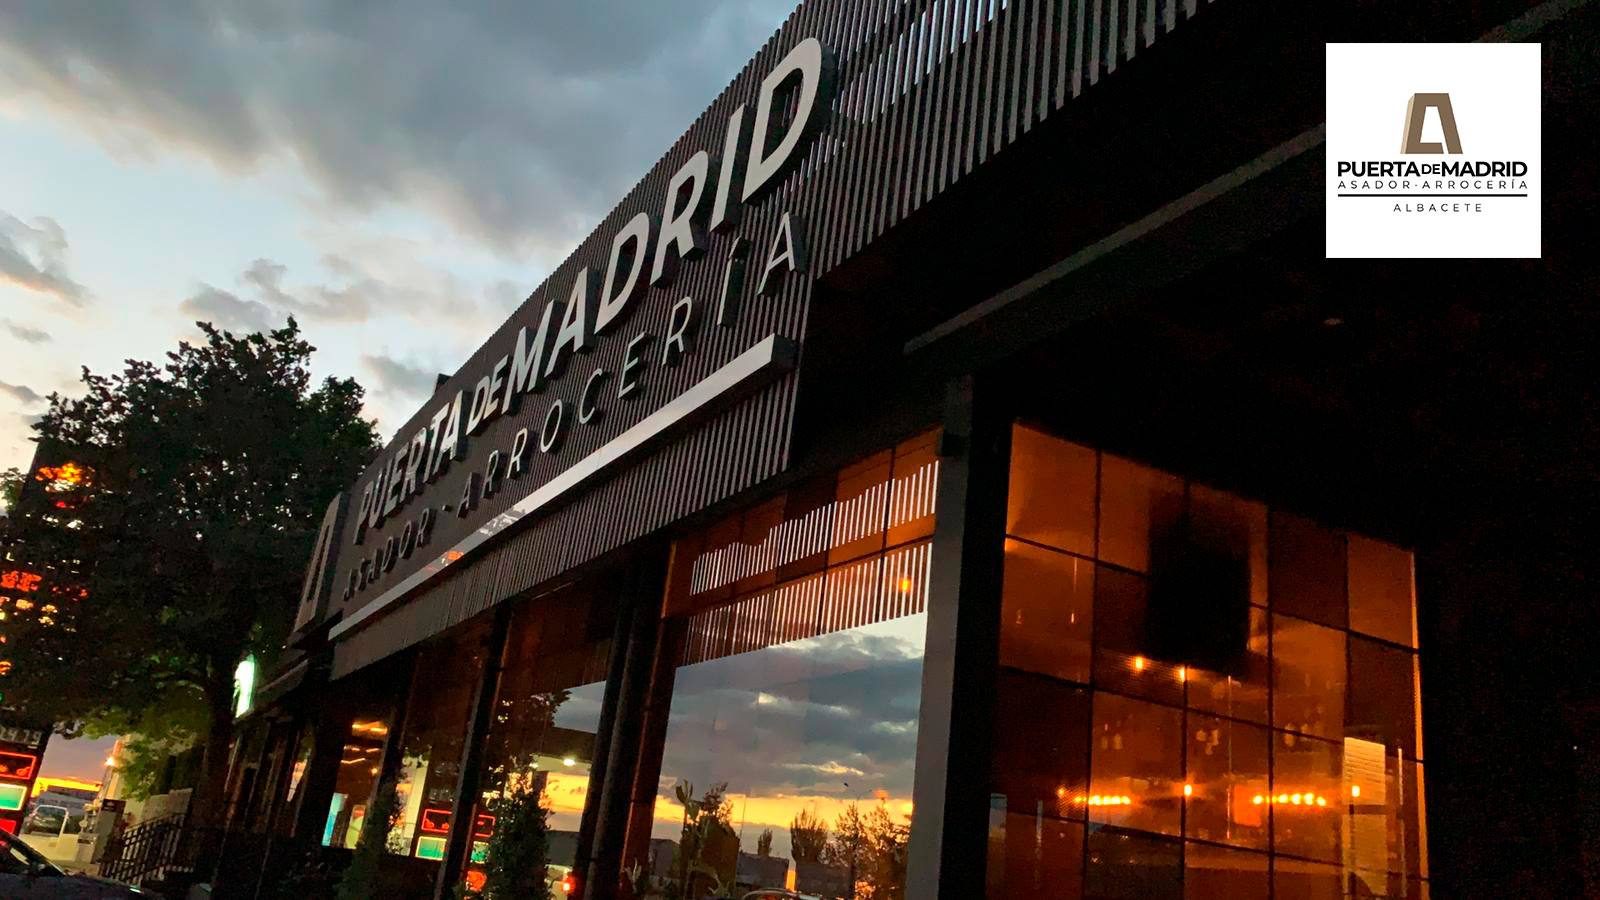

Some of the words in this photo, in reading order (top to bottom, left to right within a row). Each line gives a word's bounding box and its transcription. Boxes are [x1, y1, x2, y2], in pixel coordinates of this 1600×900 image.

[353, 389, 464, 544] PUERTA
[465, 354, 509, 436] DE
[501, 37, 823, 415] MADRID
